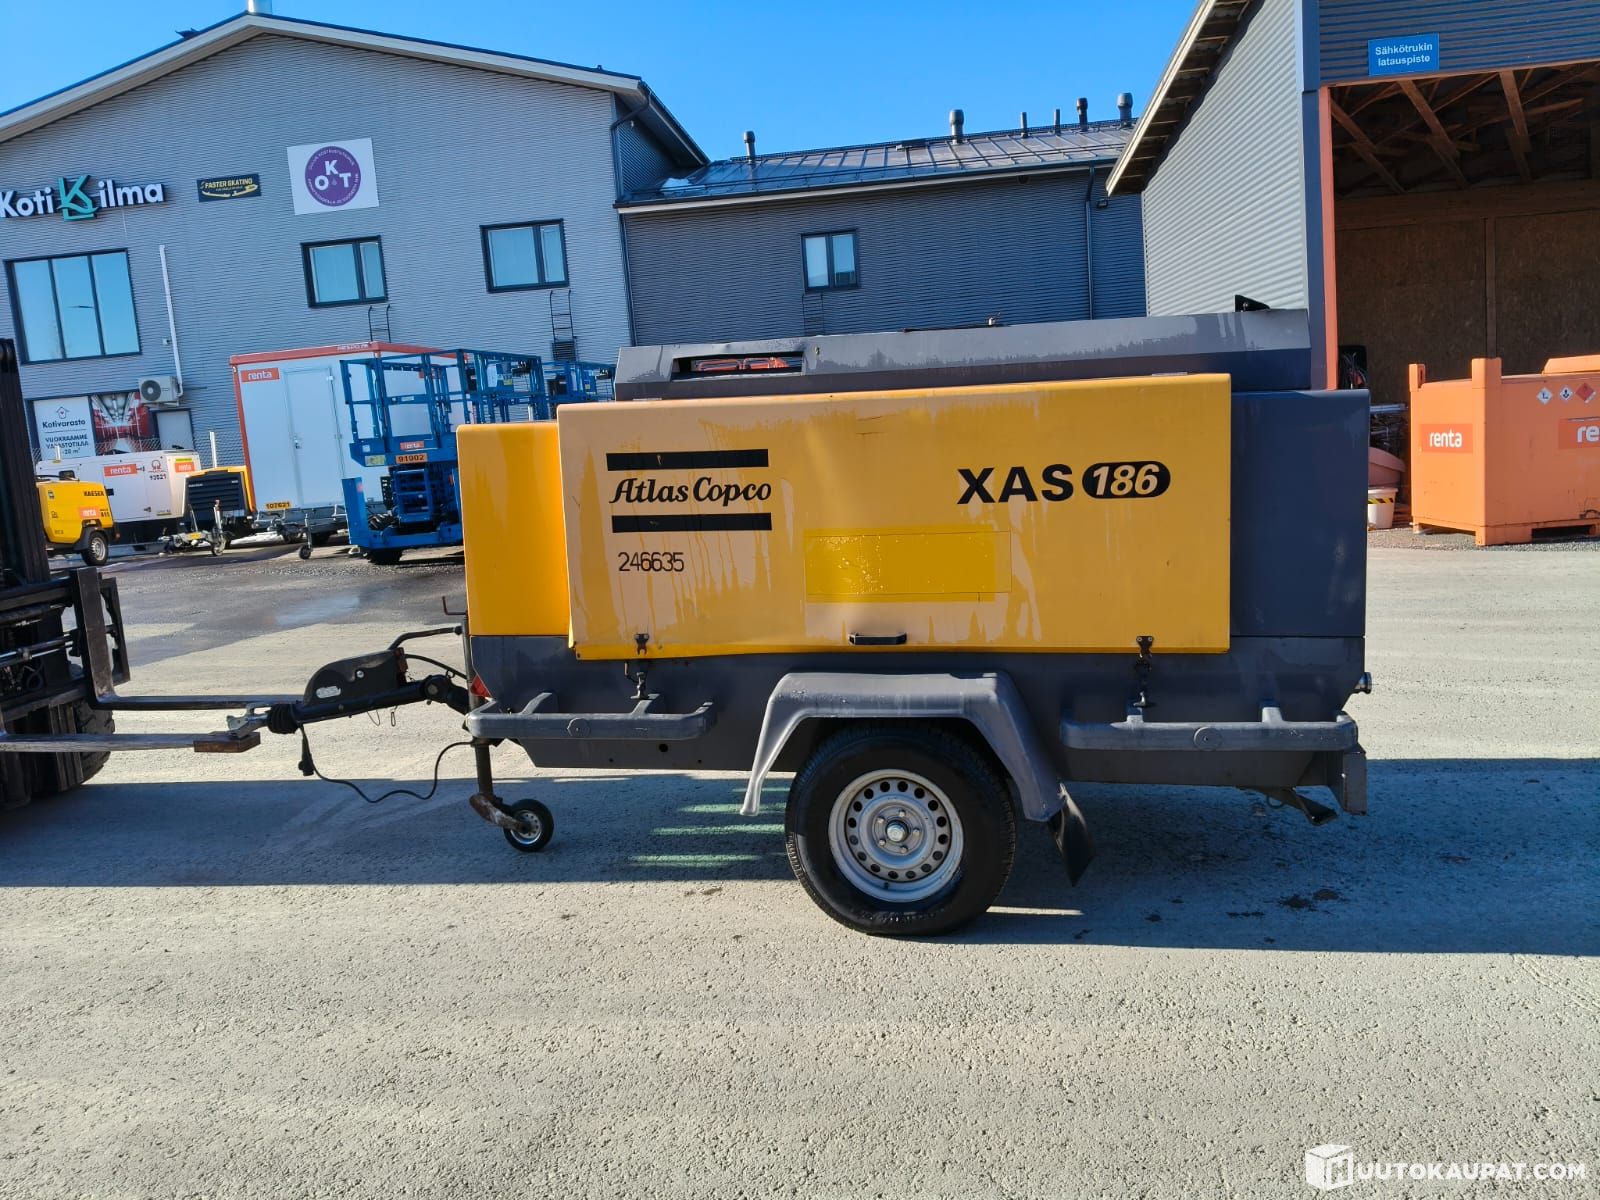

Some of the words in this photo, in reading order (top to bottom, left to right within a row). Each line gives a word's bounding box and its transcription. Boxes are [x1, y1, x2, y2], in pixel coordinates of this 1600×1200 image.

[1375, 42, 1433, 56] Sähkötrukin
[248, 370, 272, 380] renta
[42, 419, 86, 429] Kotivarasto
[1429, 429, 1463, 448] renta
[110, 466, 132, 475] renta
[609, 477, 689, 504] Atlas
[693, 476, 772, 507] Copco
[956, 463, 1075, 505] XAS
[1091, 463, 1161, 497] 186
[617, 551, 685, 572] 246635
